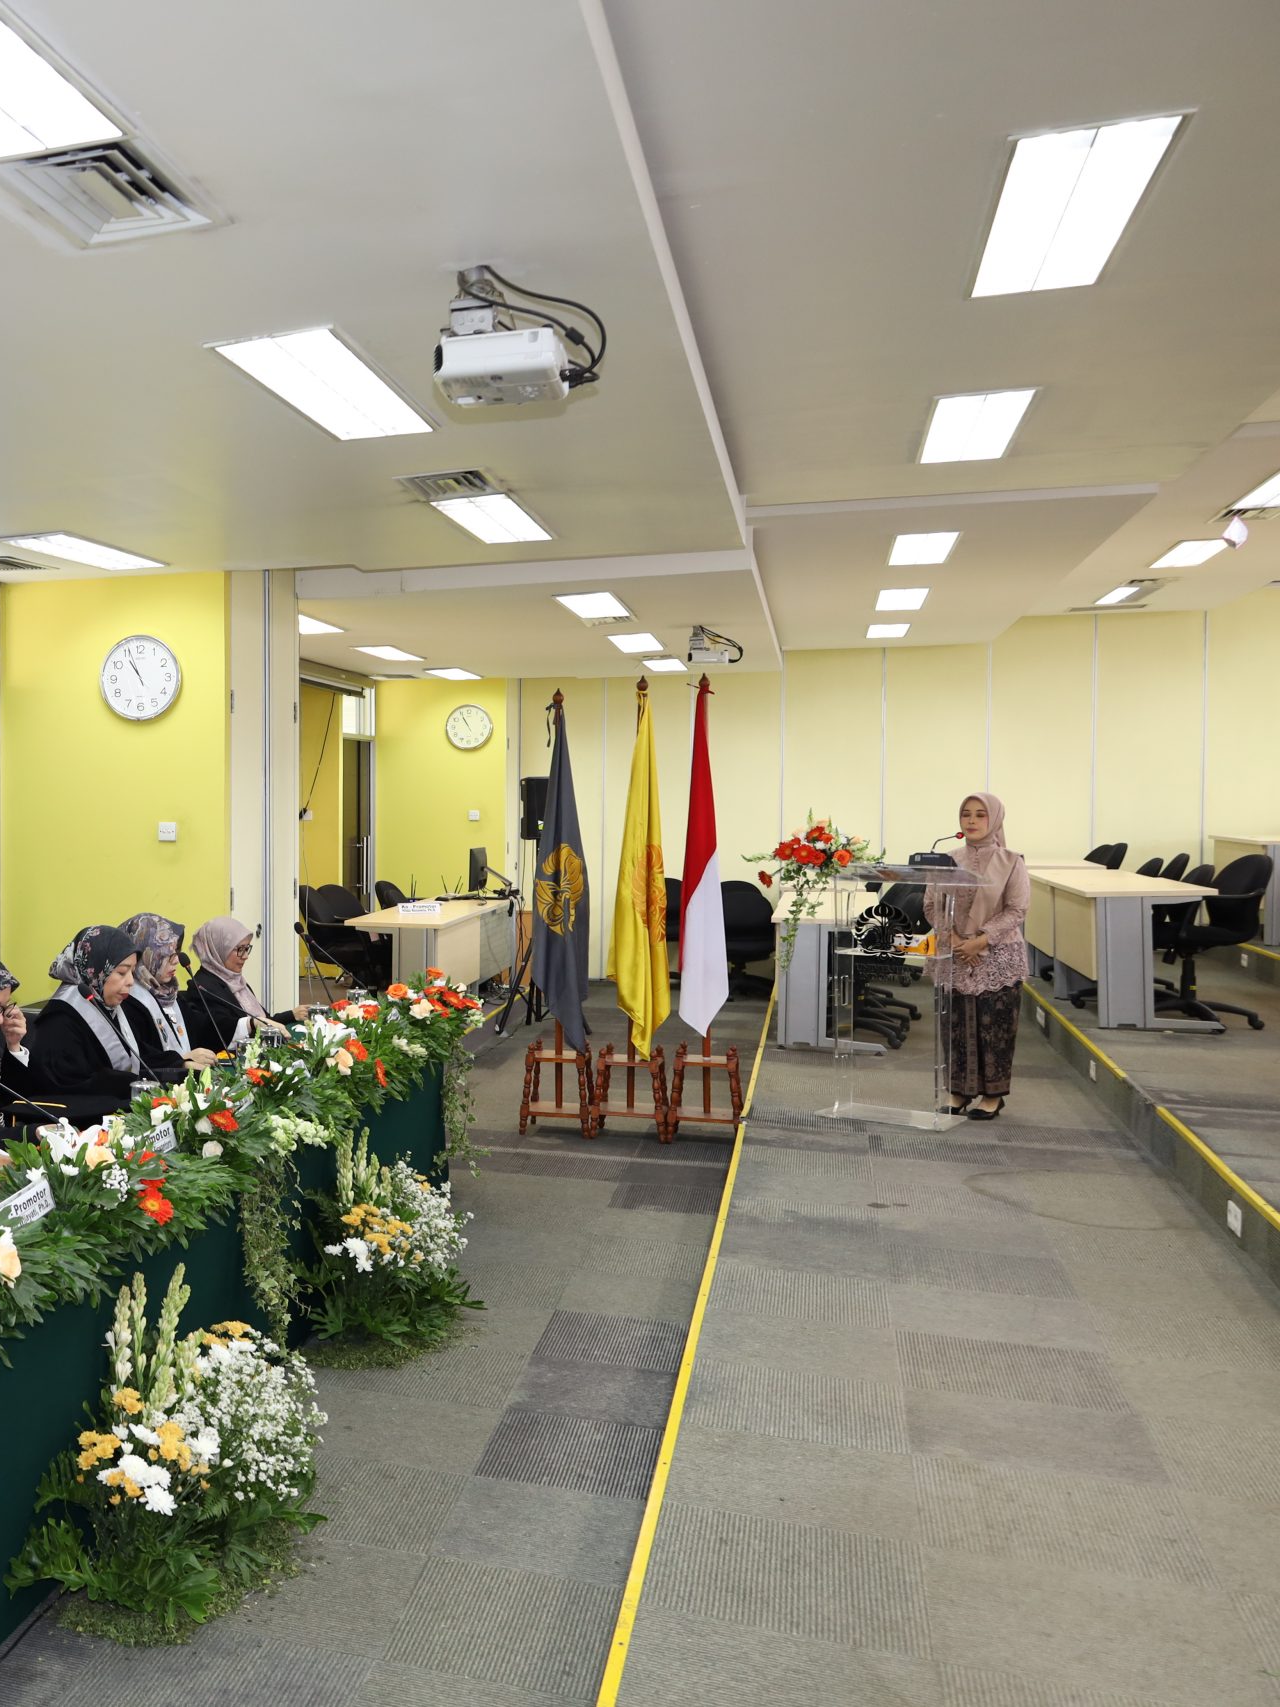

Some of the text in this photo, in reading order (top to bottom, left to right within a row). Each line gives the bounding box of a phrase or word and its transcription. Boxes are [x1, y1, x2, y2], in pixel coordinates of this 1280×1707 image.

[136, 645, 145, 654] 12
[113, 660, 123, 670] 10
[160, 658, 167, 668] 2
[110, 675, 117, 684] 9
[165, 672, 171, 681] 3
[114, 689, 121, 698] 8
[160, 687, 167, 695] 4
[125, 699, 132, 708] 7
[137, 702, 144, 711] 6
[151, 698, 158, 707] 5
[147, 1127, 171, 1143] motor
[13, 1188, 47, 1216] Promotor
